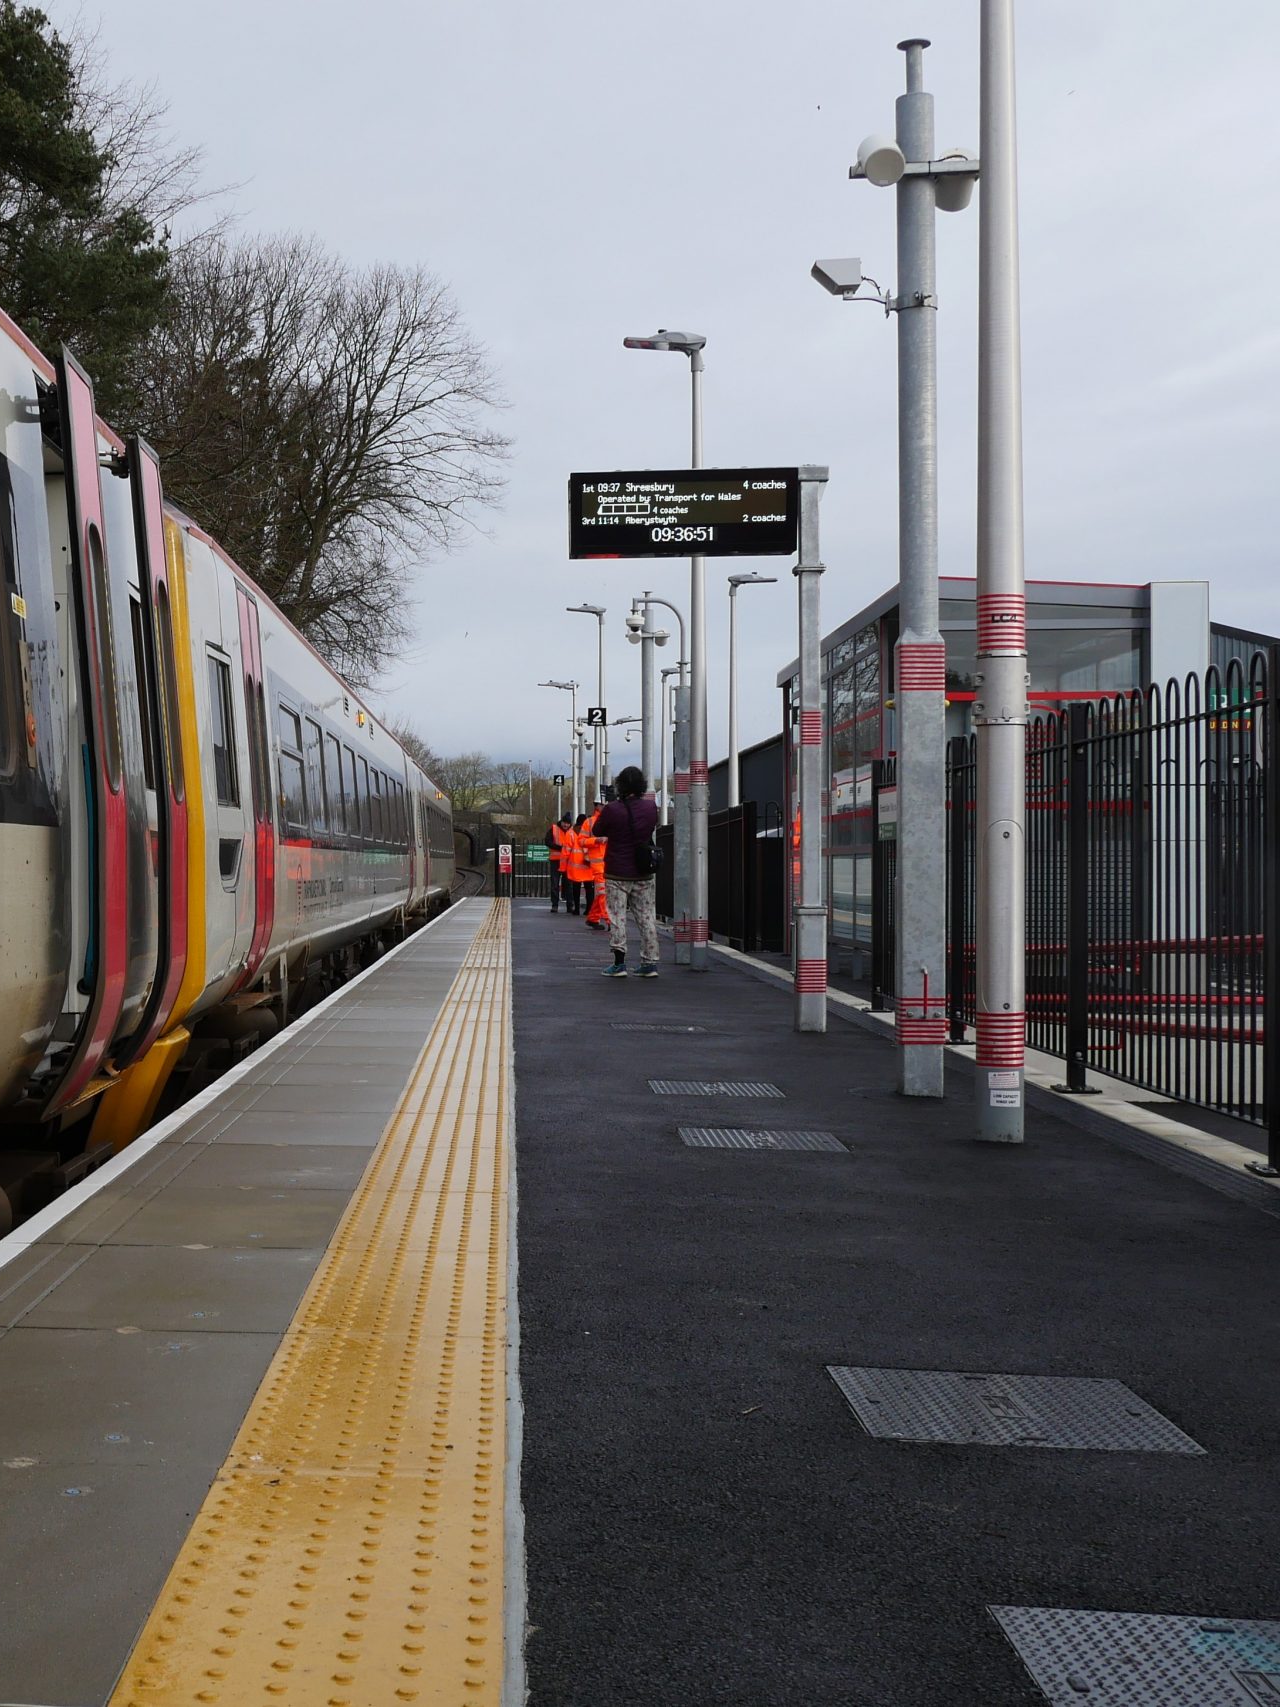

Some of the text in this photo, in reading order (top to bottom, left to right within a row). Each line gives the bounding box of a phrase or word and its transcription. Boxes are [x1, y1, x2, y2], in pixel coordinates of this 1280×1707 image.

[582, 483, 595, 493] 1st
[597, 482, 620, 492] 09:37
[742, 480, 787, 489] 4 coaches
[597, 494, 637, 505] Operated
[654, 493, 698, 503] Transport
[700, 493, 715, 501] for
[718, 492, 741, 501] Wales
[652, 506, 689, 514] 4 coaches
[581, 515, 677, 526] 3rd 11:14 Aberystwyth
[742, 513, 787, 523] 2 coaches
[651, 526, 714, 542] 09:36:51
[592, 709, 602, 722] 2
